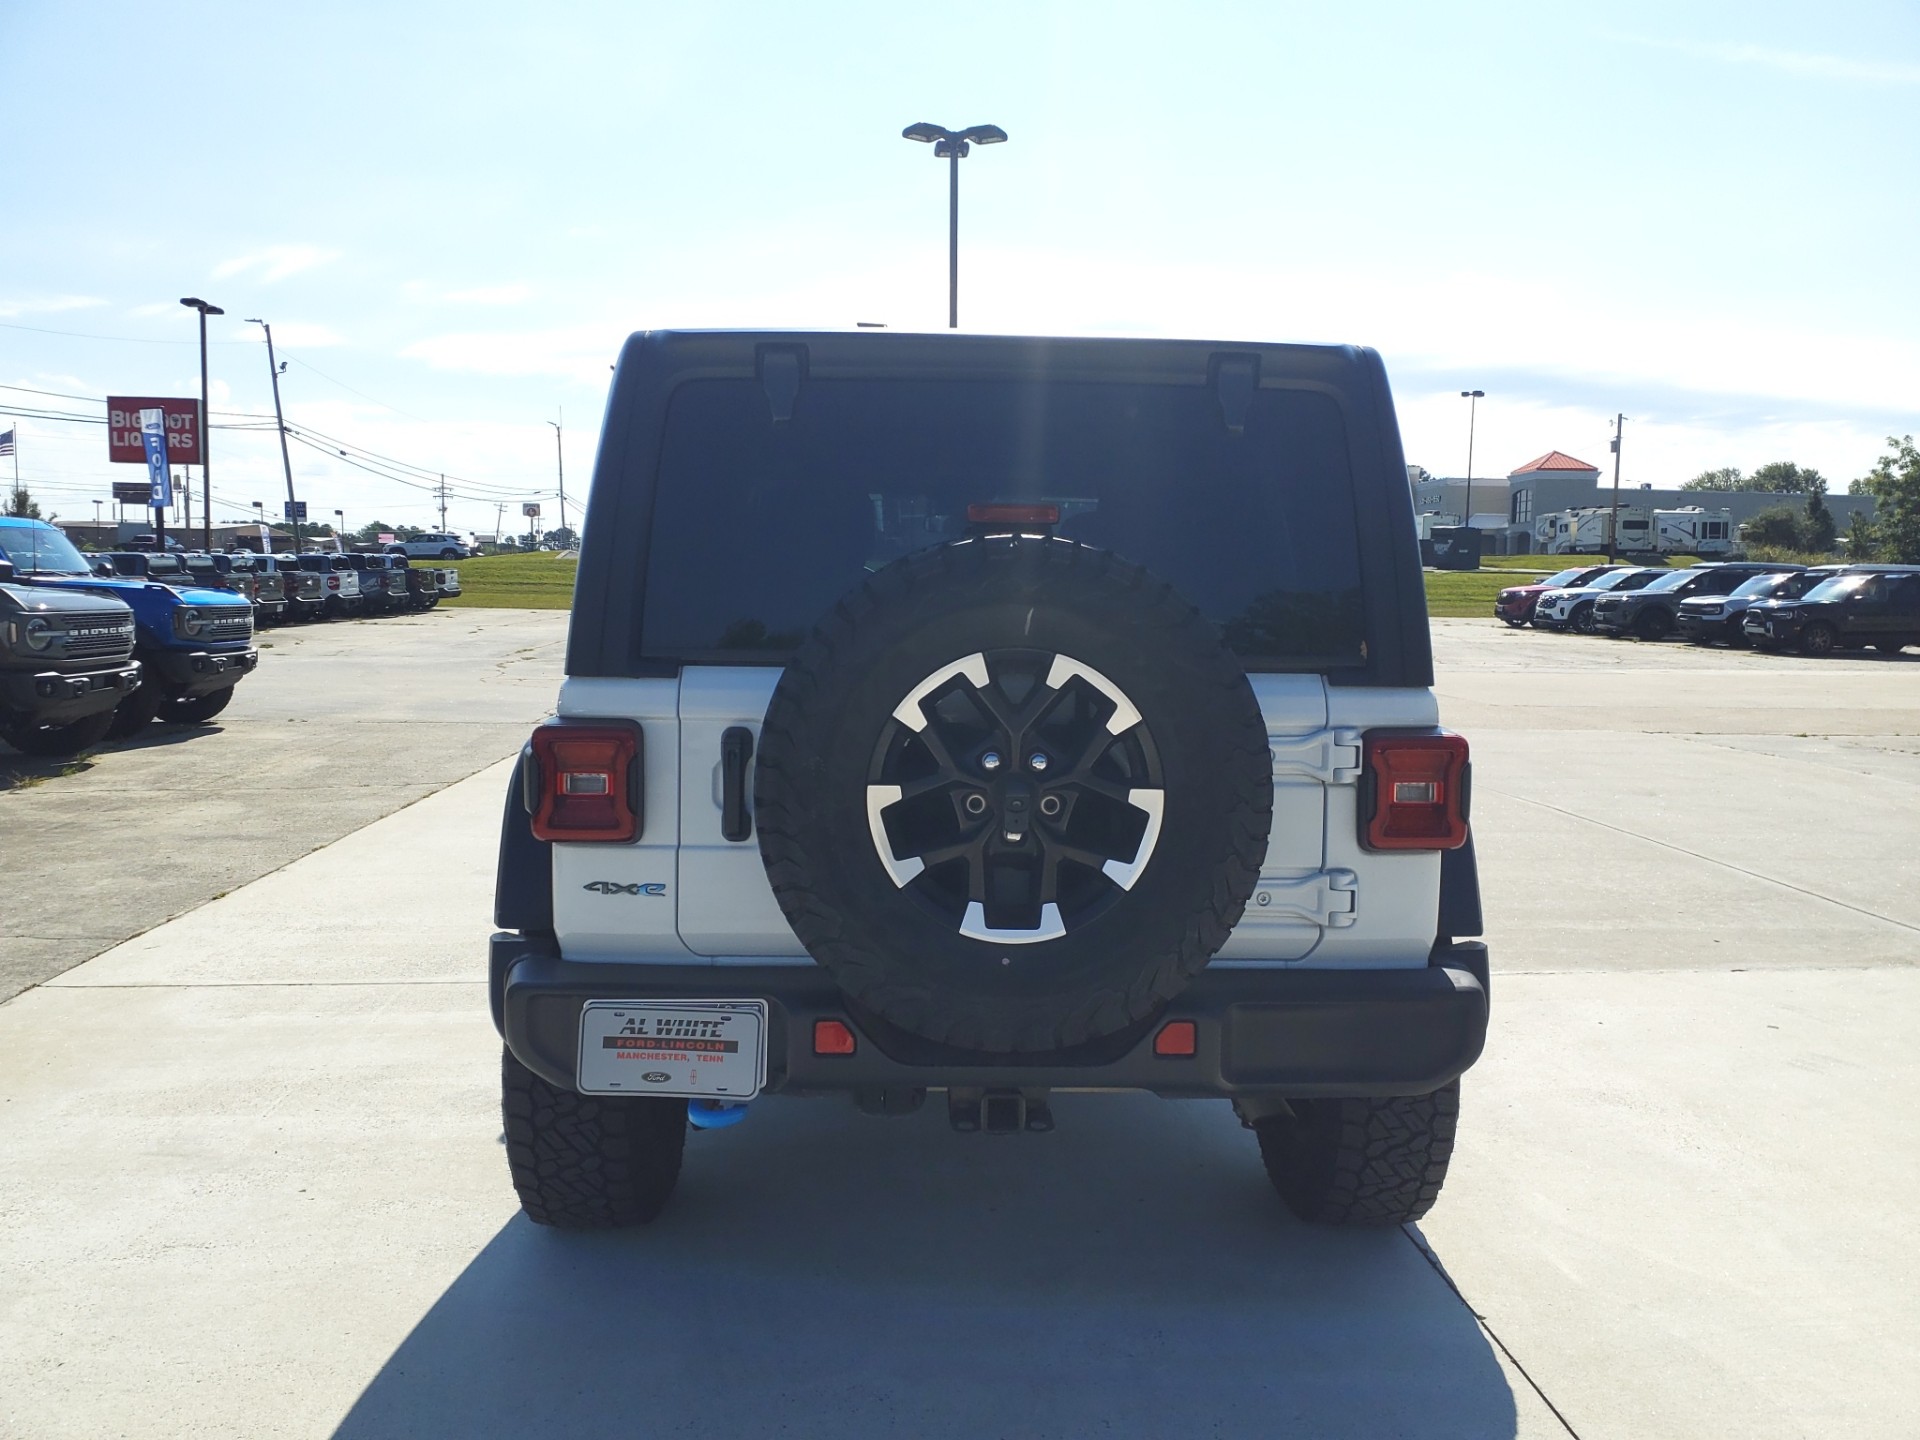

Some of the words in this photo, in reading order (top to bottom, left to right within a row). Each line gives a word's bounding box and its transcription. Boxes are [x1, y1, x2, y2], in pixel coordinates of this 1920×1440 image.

[112, 431, 193, 448] LIQRS
[69, 626, 126, 636] BRONCO
[619, 1018, 648, 1035] AL
[656, 1018, 725, 1038] WHITE
[616, 1052, 690, 1062] MANCHESTER,
[696, 1054, 724, 1063] TENN
[646, 1072, 667, 1082] Ford
